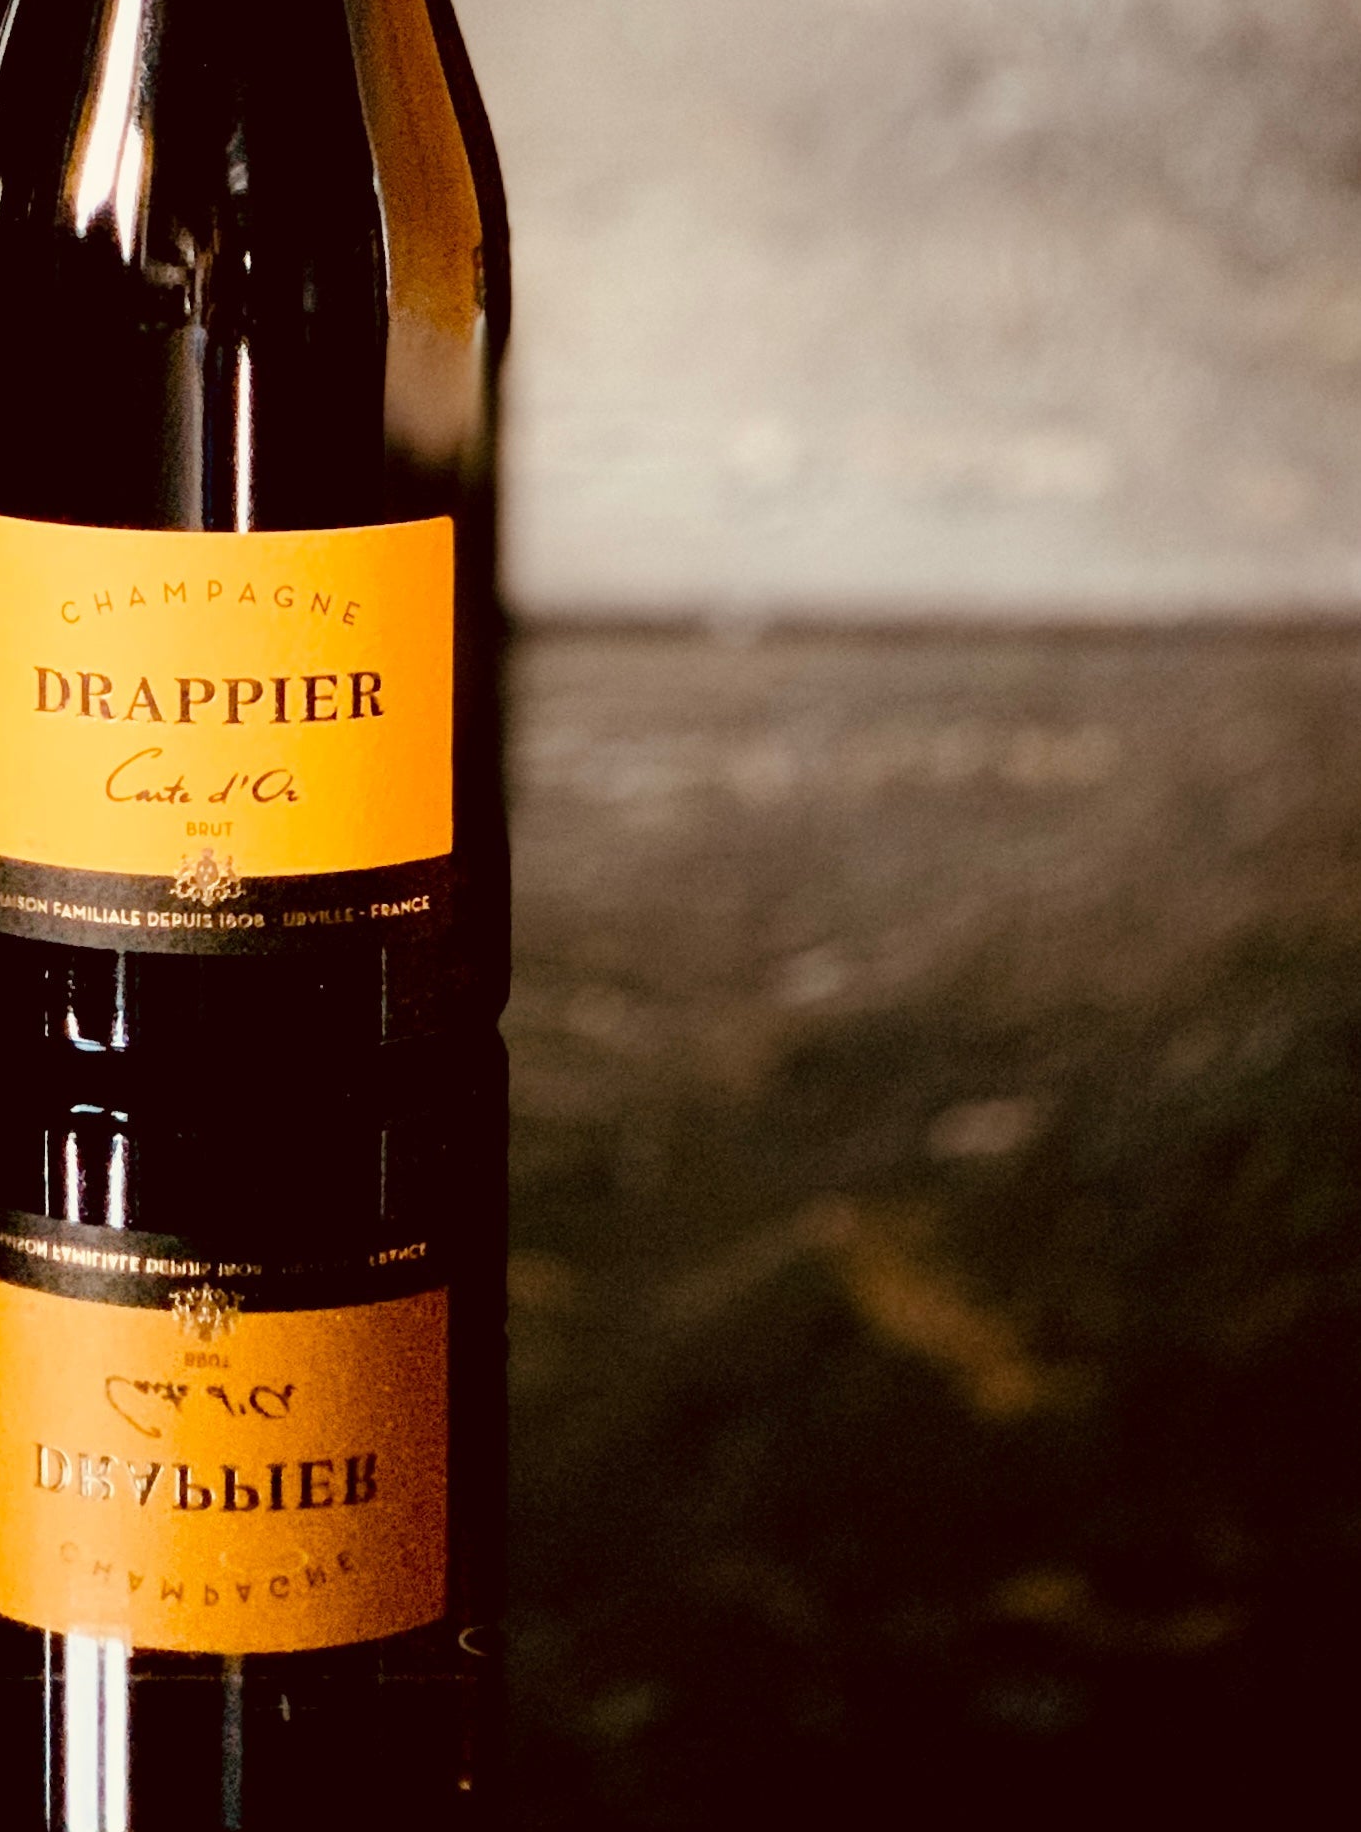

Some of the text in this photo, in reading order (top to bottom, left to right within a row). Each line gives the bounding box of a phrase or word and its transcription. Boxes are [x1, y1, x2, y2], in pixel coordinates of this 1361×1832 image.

[61, 579, 361, 626] CHAMPAGNE
[33, 665, 385, 726] DRAPPIER
[105, 747, 299, 805] Carte d'Or
[185, 821, 235, 837] BRUT
[53, 901, 141, 927] FAMILIALE
[147, 911, 213, 928] DEPUIS
[369, 894, 430, 919] FRANCE
